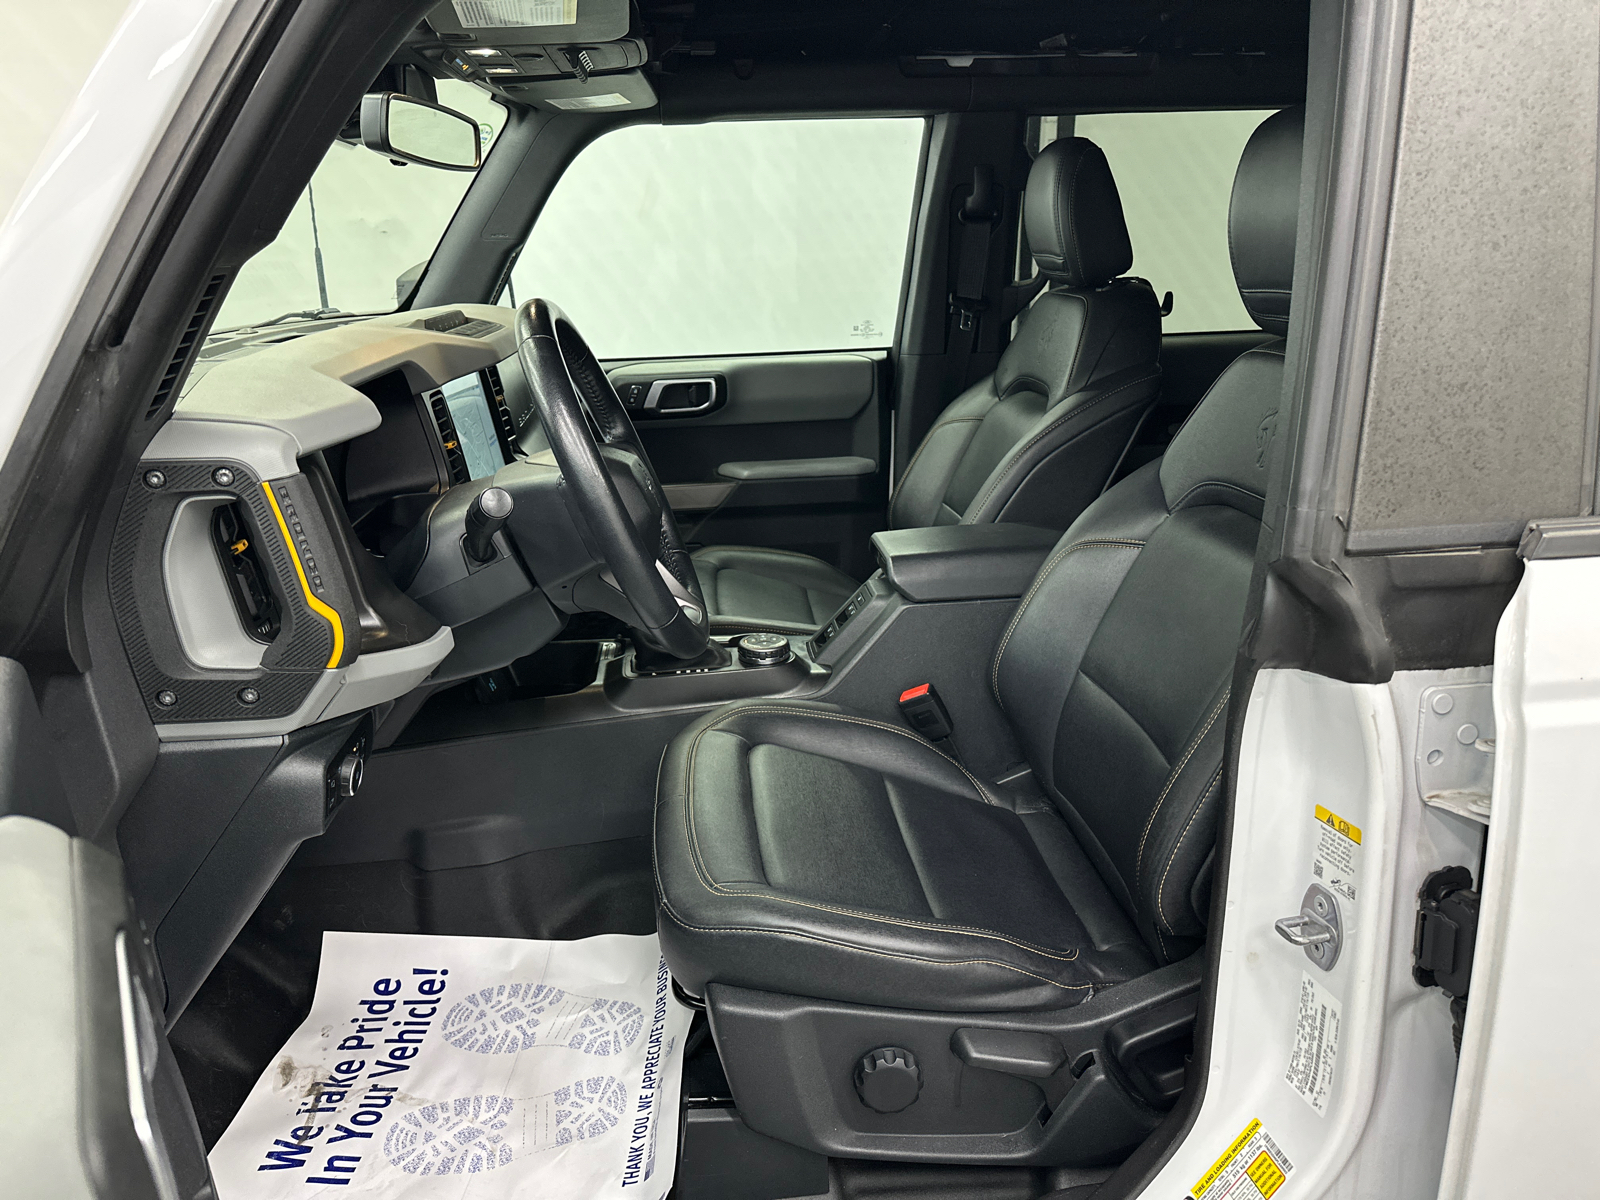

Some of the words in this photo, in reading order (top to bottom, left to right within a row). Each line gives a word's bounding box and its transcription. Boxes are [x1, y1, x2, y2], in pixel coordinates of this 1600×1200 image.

[278, 486, 324, 593] BRONCO
[657, 954, 668, 995] BUSIN
[367, 968, 448, 1079] Vehicle!
[653, 993, 666, 1026] YOUR
[257, 1125, 324, 1171] We
[337, 978, 401, 1050] Pride
[642, 1024, 664, 1089] APPRECIATE
[326, 1084, 398, 1144] Your
[631, 1112, 652, 1143] YOU,
[637, 1092, 654, 1112] WE
[305, 1155, 362, 1185] In
[622, 1143, 644, 1188] THANK
[1194, 1183, 1206, 1195] TIRE
[1204, 1173, 1214, 1184] AND
[1213, 1153, 1232, 1174] LOADING
[1230, 1121, 1259, 1154] INFORMATION
